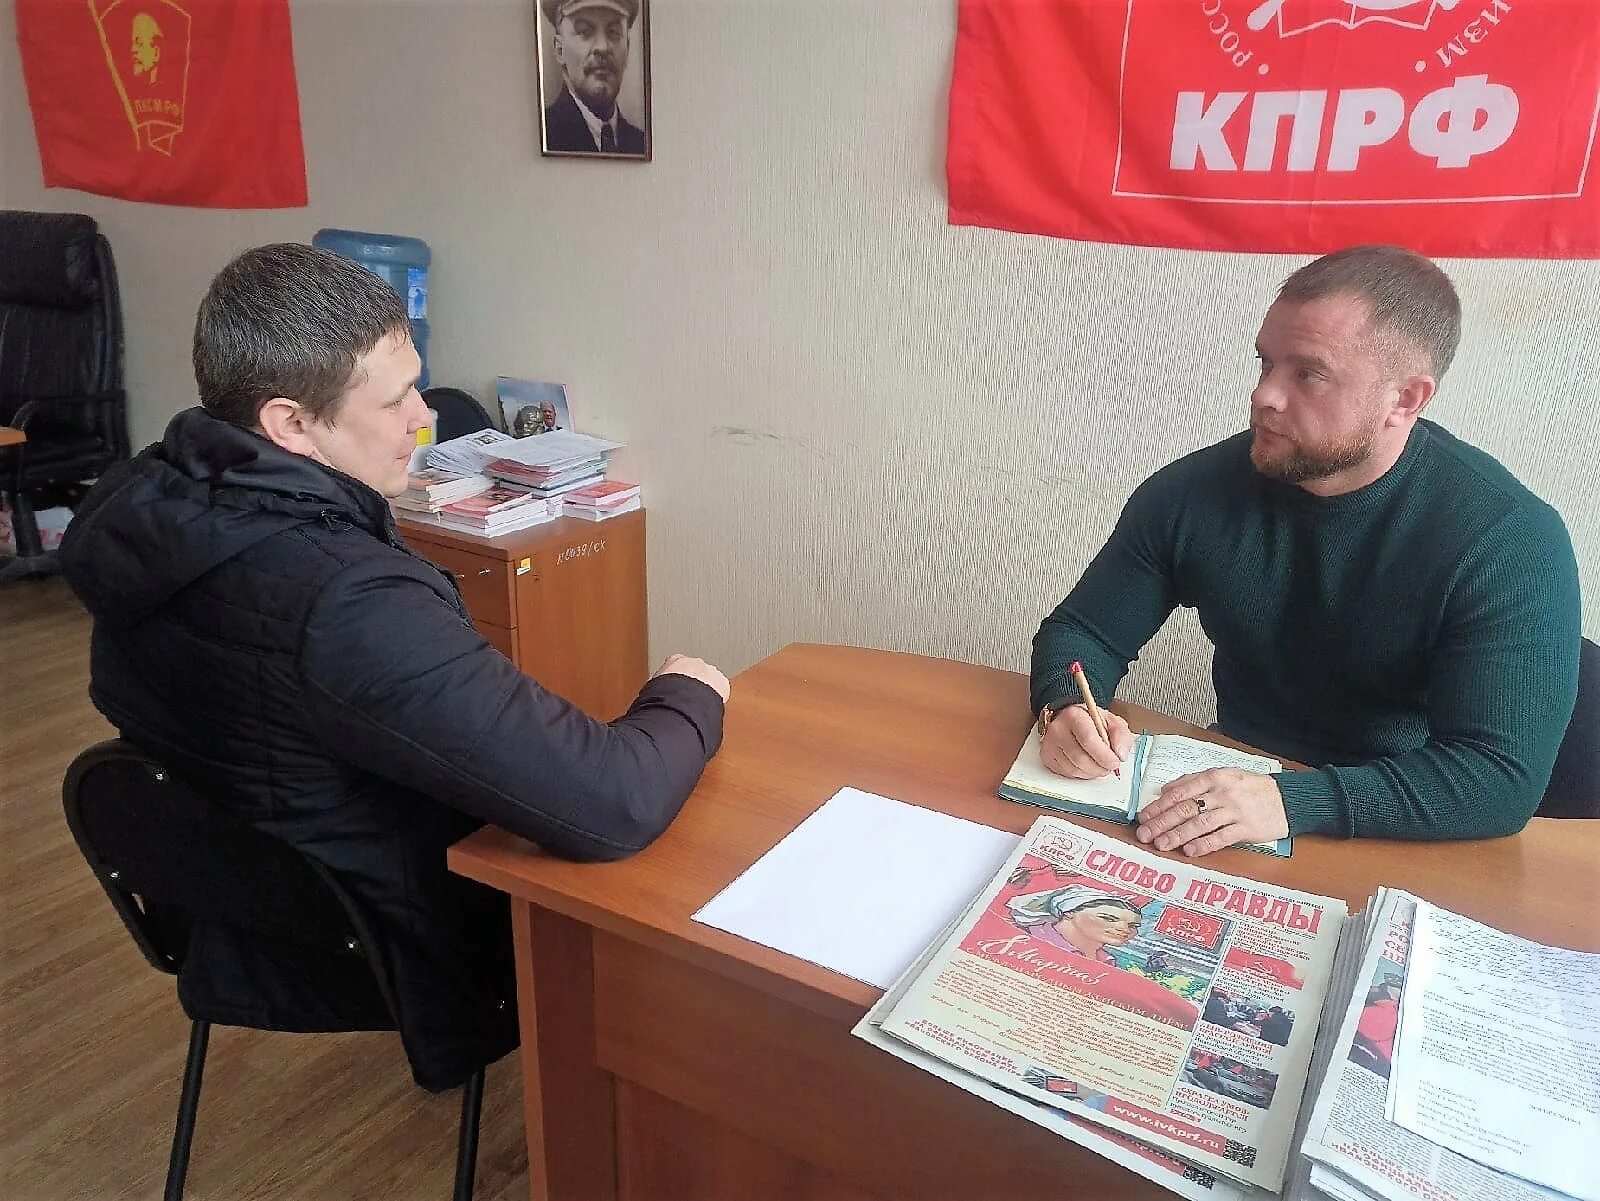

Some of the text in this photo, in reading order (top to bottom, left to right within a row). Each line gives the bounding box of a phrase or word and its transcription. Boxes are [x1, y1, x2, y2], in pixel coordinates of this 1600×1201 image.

[1170, 74, 1520, 172] КПРФ
[1085, 849, 1177, 894] СЛОВО
[1184, 878, 1324, 935] ПРАВДЫ
[1113, 1103, 1220, 1150] www.ivkprf.ru
